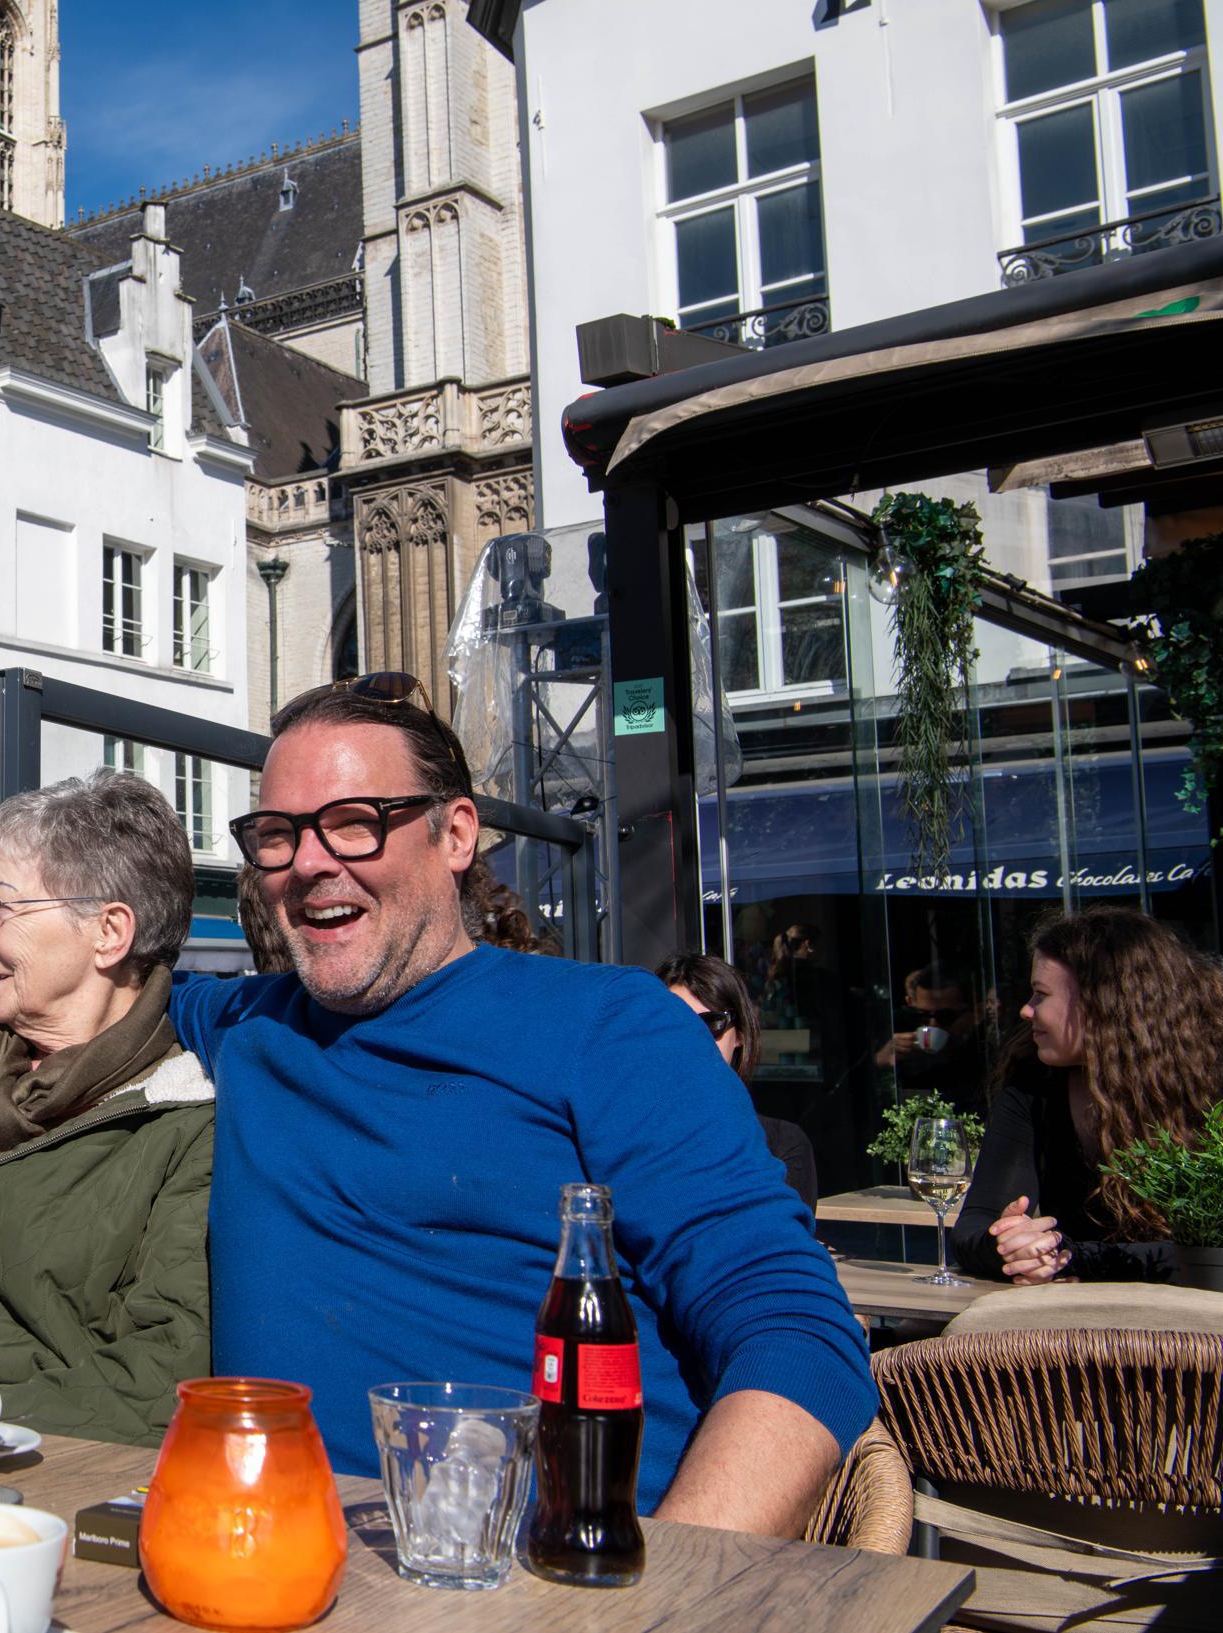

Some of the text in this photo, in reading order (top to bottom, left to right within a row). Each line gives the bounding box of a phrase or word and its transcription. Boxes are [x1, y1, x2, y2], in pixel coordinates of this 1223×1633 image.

[875, 866, 1048, 891] Leonidas
[79, 1531, 130, 1549] Marlboro Prime
